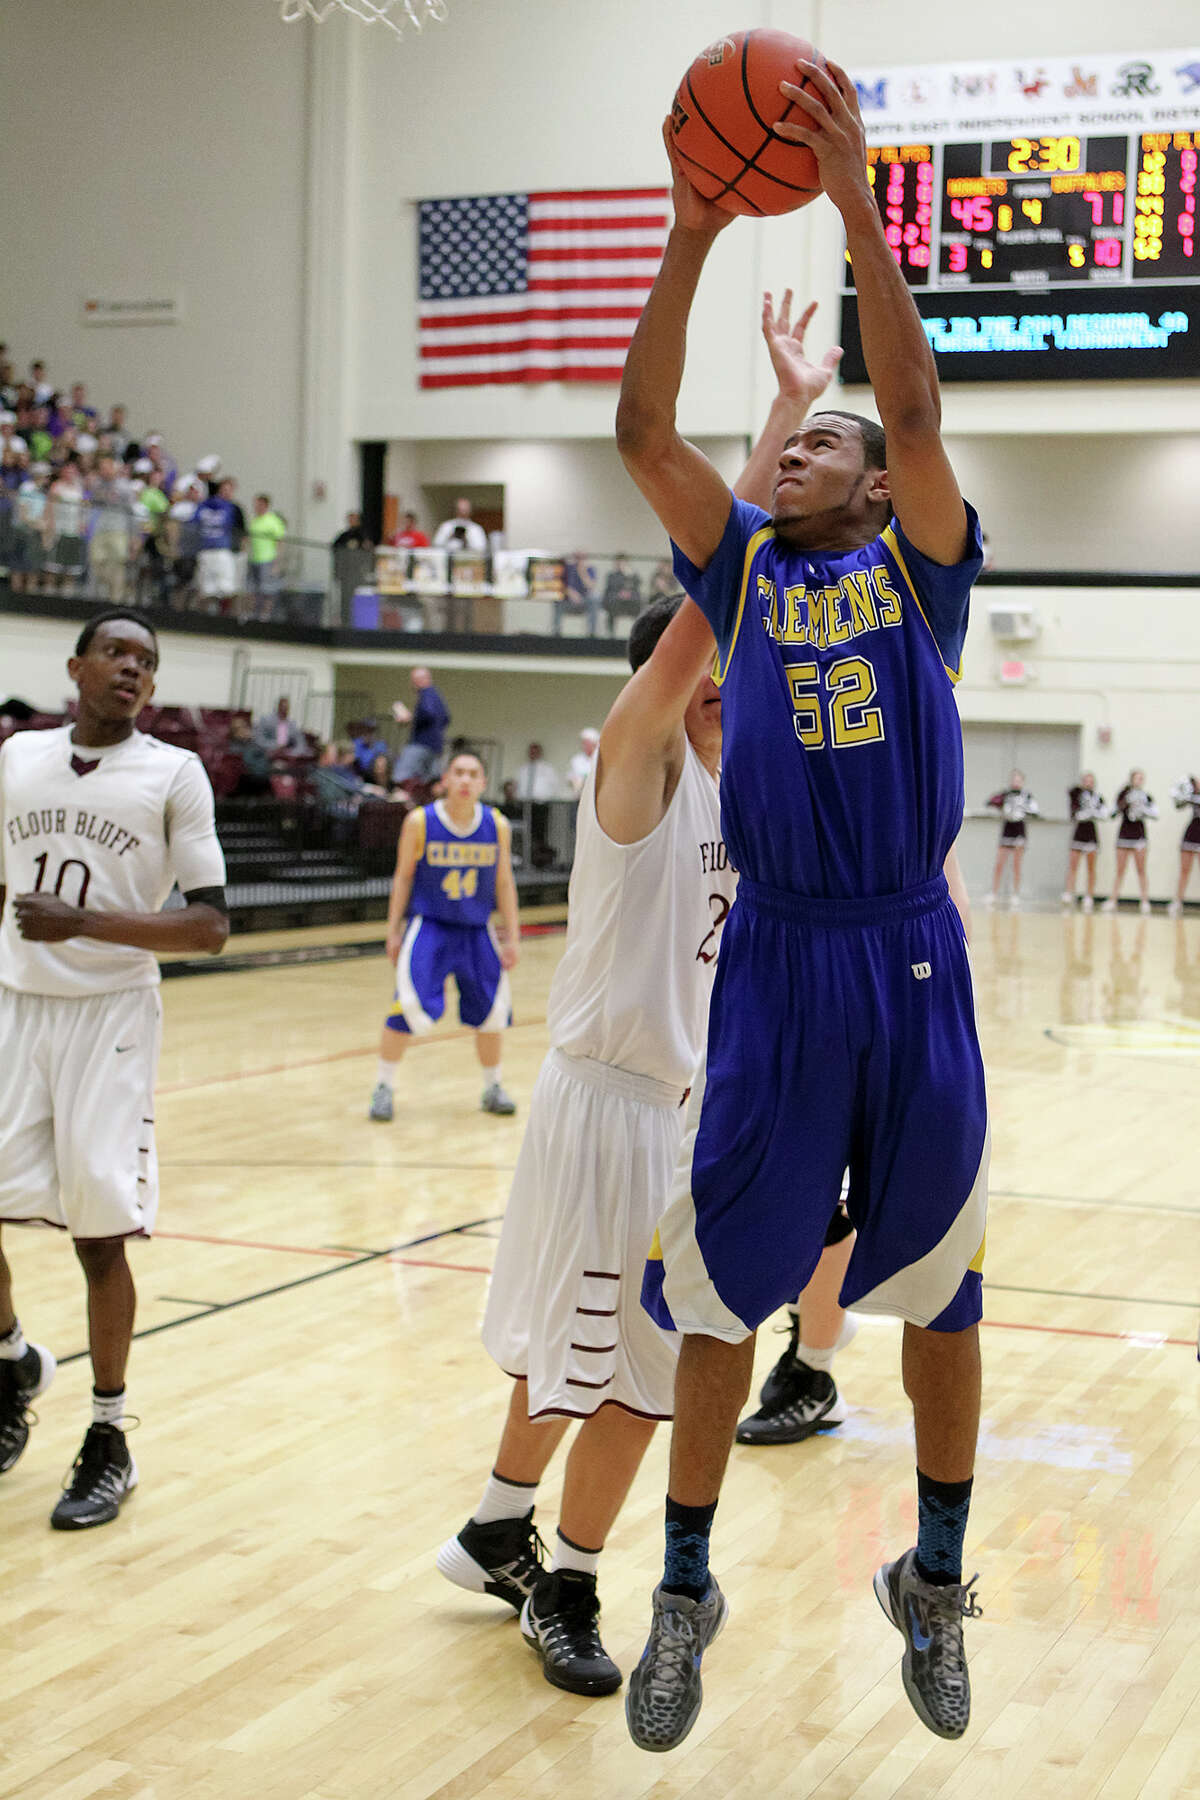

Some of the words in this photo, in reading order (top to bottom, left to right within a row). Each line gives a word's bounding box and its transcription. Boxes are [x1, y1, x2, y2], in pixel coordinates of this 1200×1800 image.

[1008, 136, 1080, 174] 2:30
[951, 196, 994, 232] 45
[1022, 198, 1042, 225] 4
[1083, 191, 1124, 225] 71
[949, 242, 968, 272] 3
[783, 655, 886, 751] 52
[7, 808, 67, 845] FLOUR
[74, 810, 141, 857] BLUFF
[34, 851, 91, 908] 10
[442, 868, 478, 900] 44
